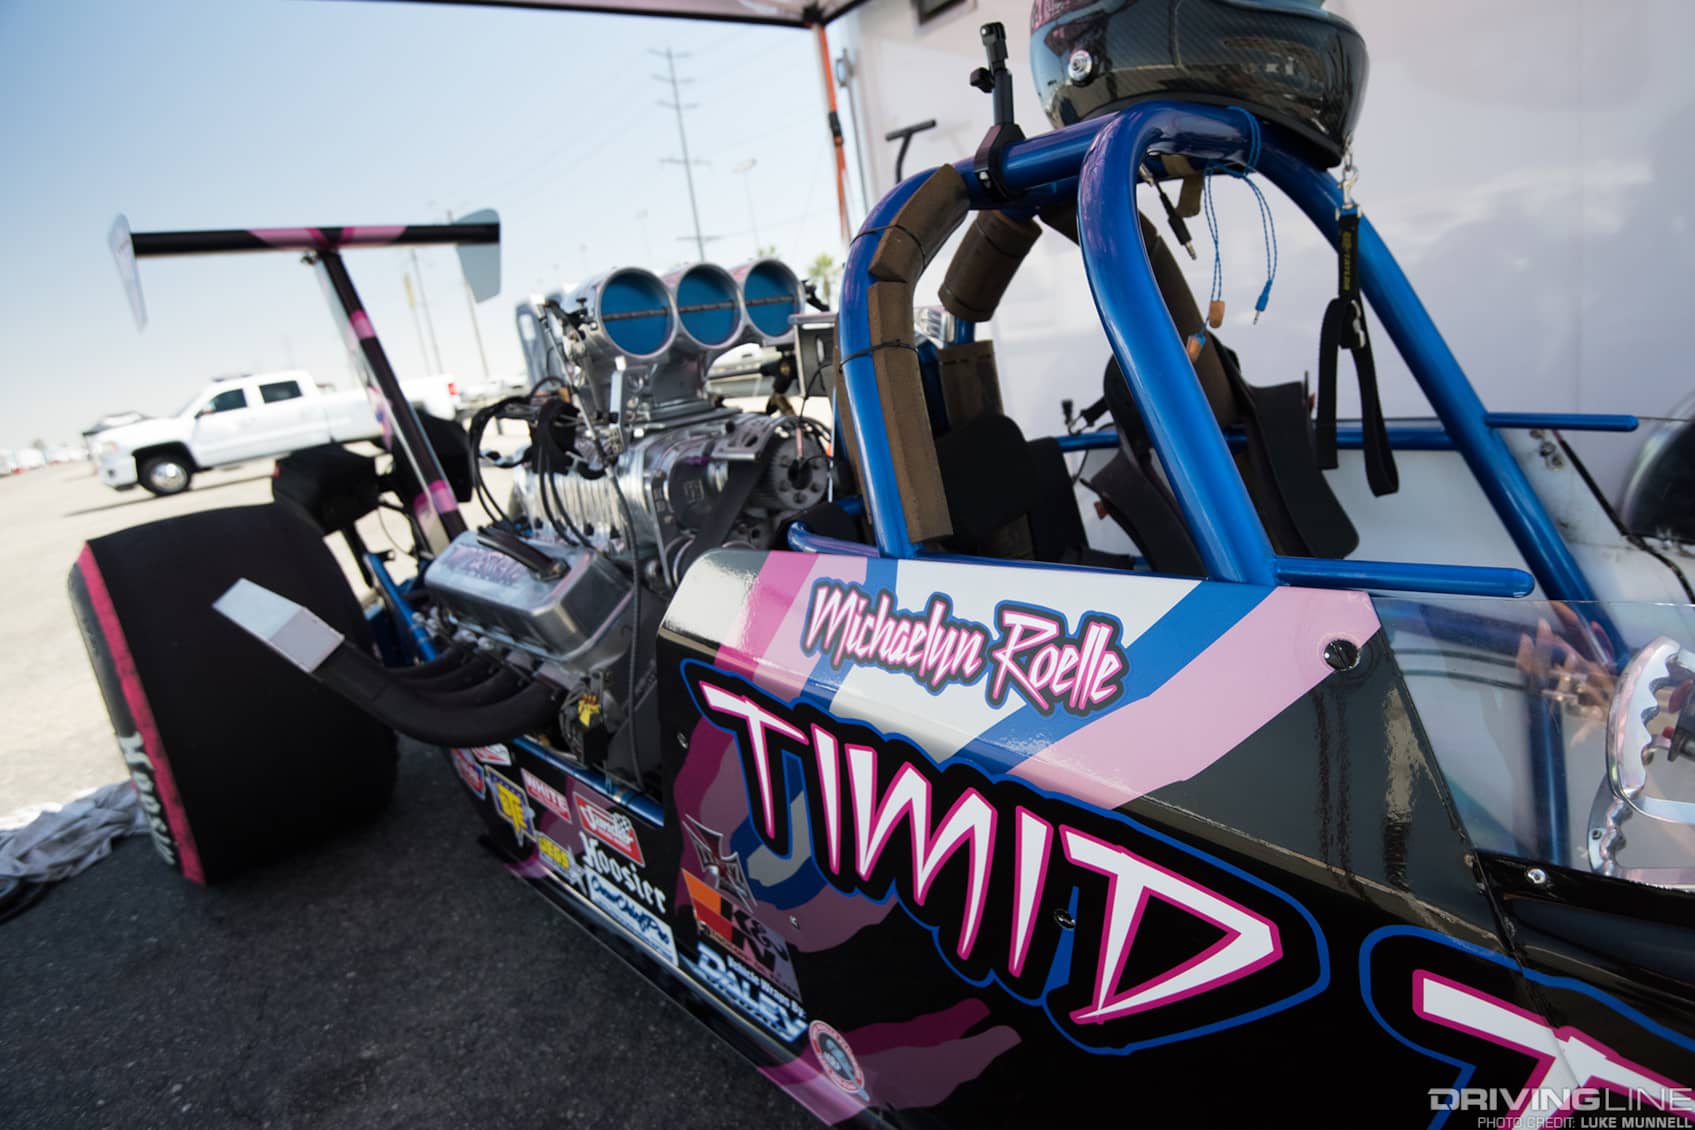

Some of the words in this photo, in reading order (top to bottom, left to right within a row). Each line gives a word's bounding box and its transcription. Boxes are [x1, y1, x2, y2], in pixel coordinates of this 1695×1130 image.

[806, 584, 985, 689] Michaelyn
[991, 608, 1124, 711] Roelle
[578, 830, 667, 915] Hoosier
[698, 680, 1284, 1025] TIMID
[697, 941, 809, 1043] DALEY
